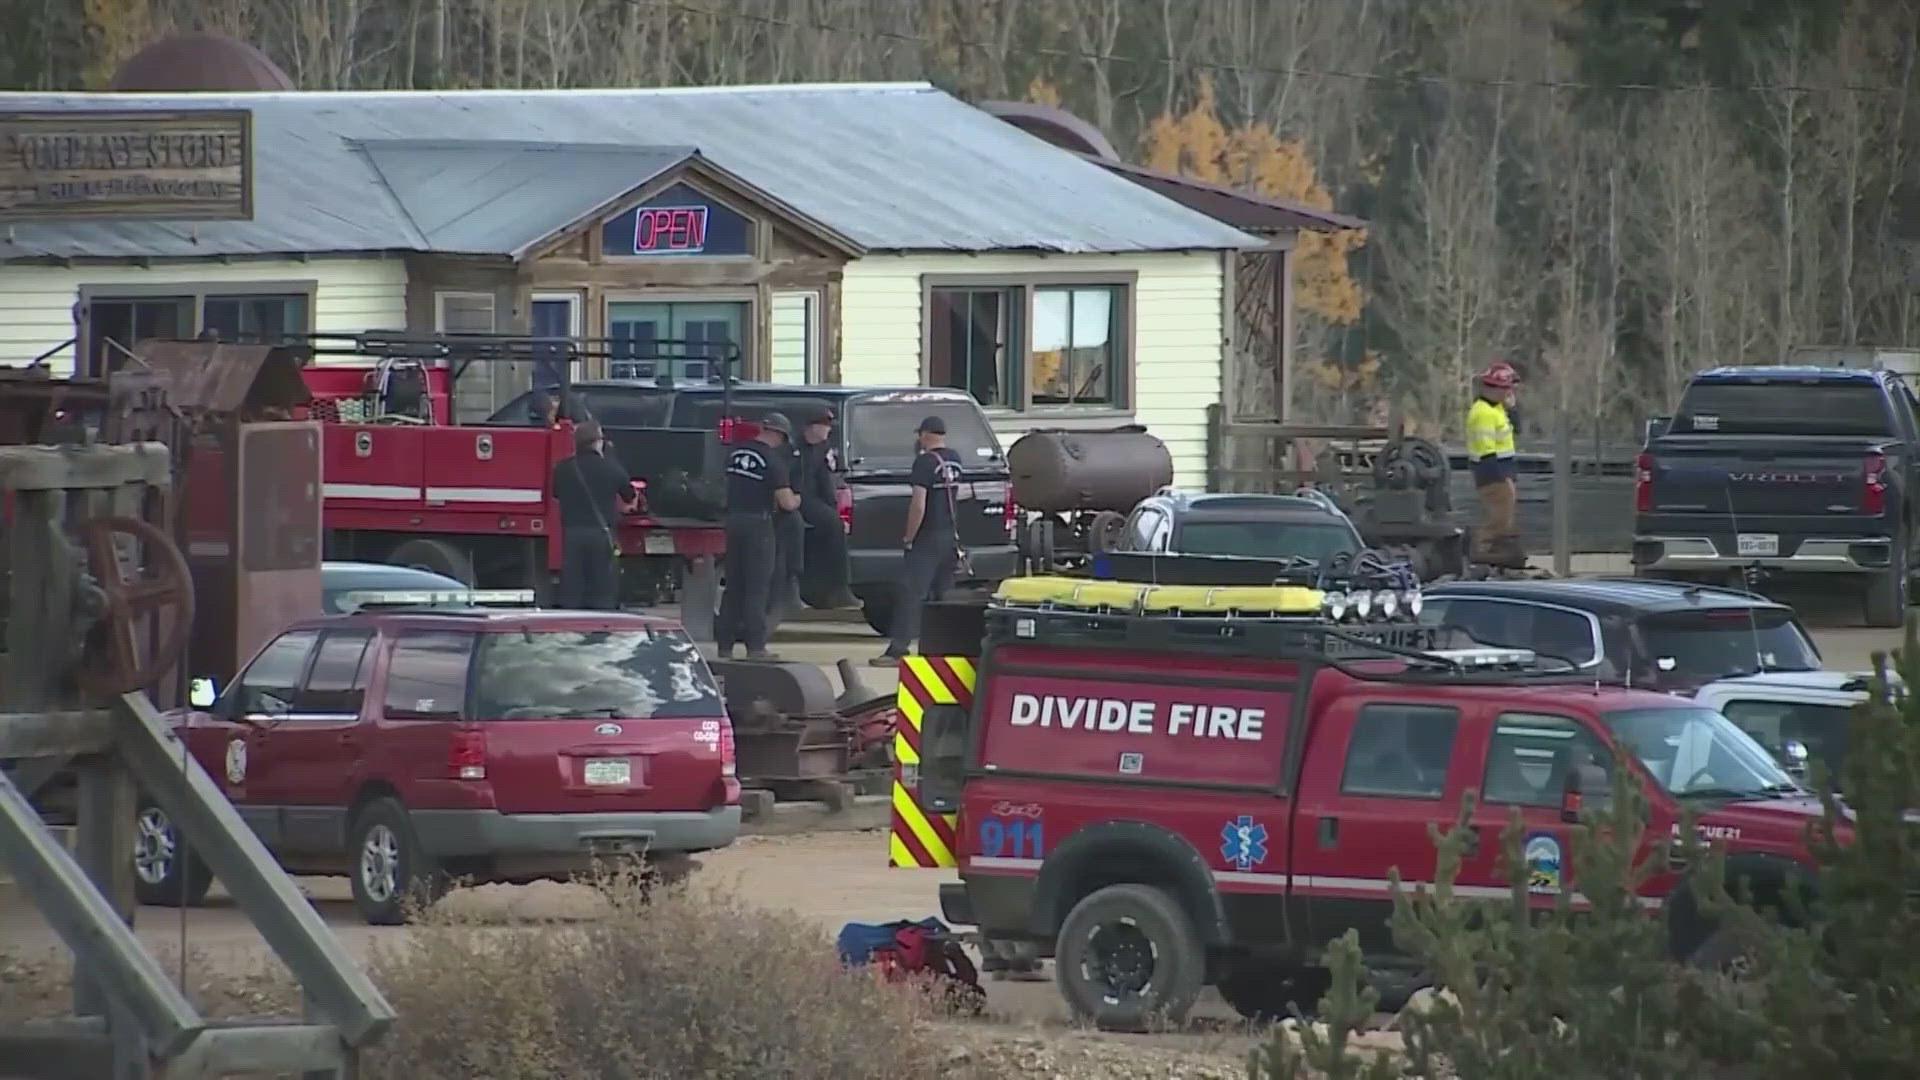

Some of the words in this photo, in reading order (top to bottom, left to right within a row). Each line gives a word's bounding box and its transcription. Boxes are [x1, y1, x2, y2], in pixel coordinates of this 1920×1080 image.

[638, 210, 704, 249] OPEN
[1010, 694, 1156, 734] DIVIDE
[1167, 704, 1265, 741] FIRE
[980, 818, 1044, 858] 911
